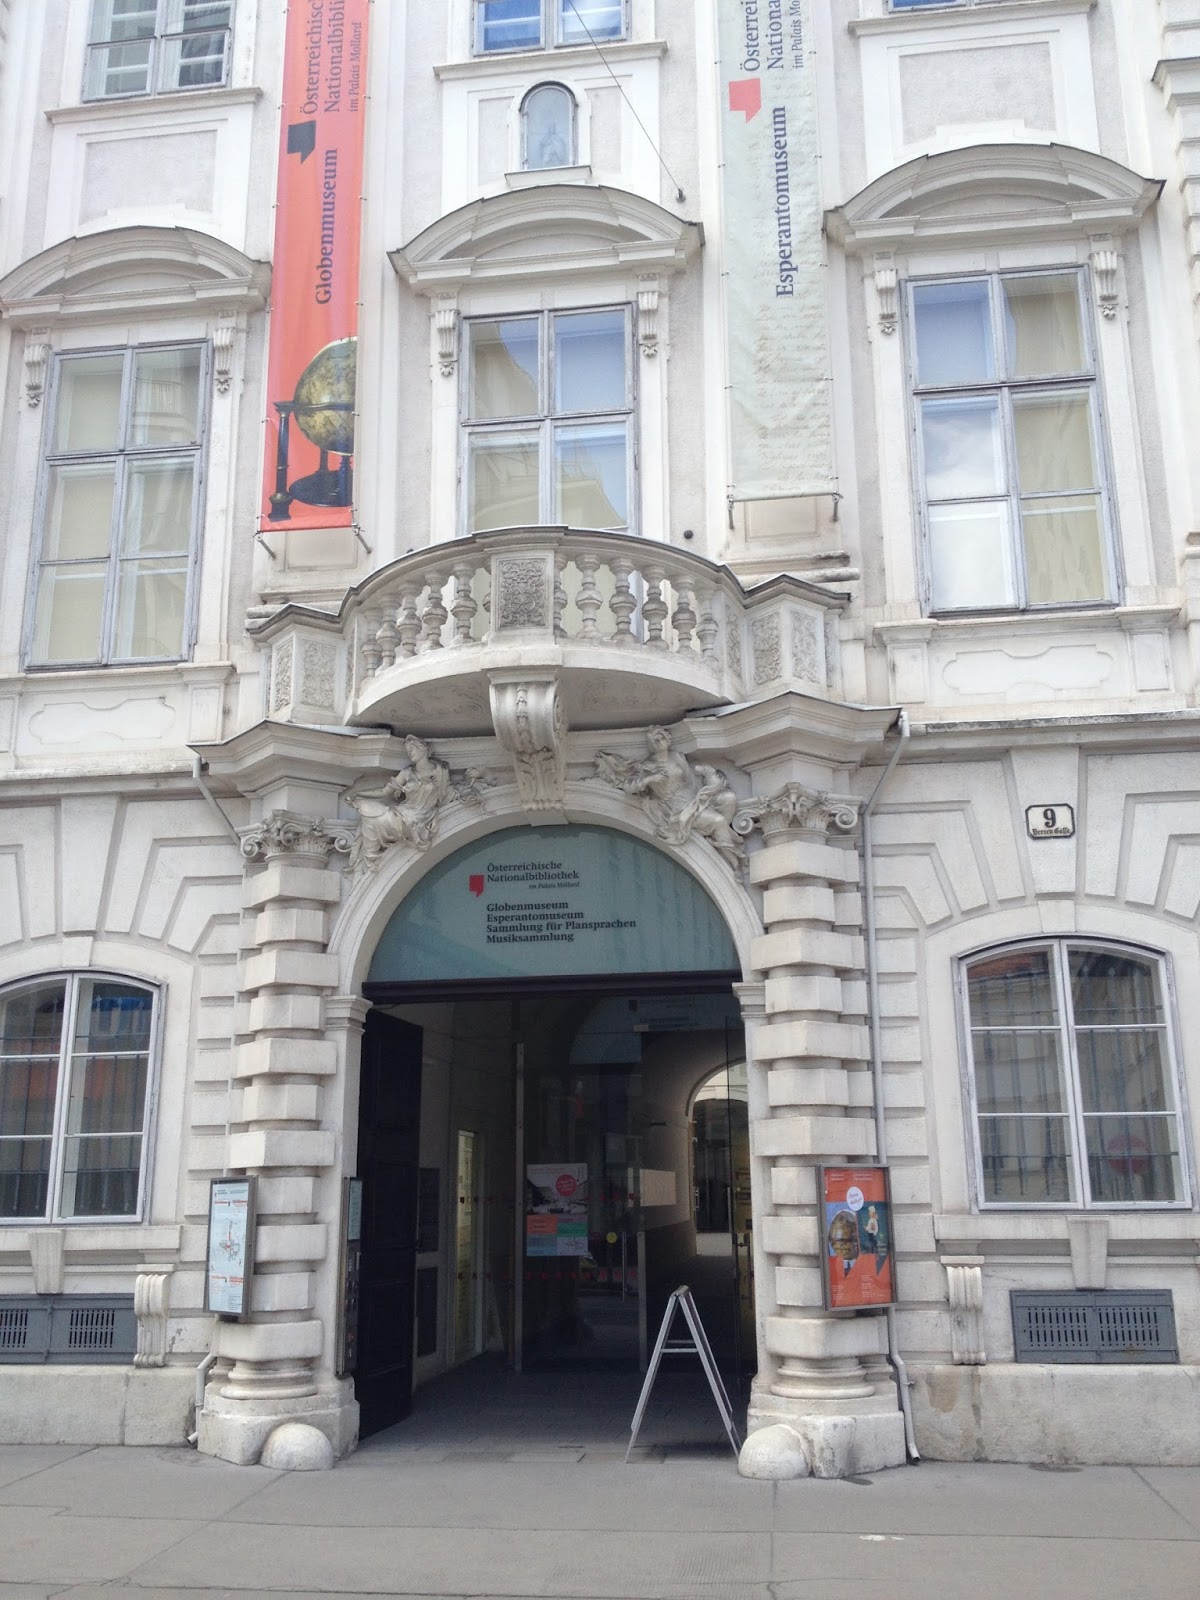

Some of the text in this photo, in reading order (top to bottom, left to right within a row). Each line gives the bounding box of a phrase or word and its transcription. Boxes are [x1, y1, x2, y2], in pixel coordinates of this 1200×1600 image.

[790, 19, 803, 51] Palais
[301, 0, 323, 114] Österreichisc
[793, 54, 804, 69] im
[348, 22, 362, 112] im Palais Mollard
[774, 106, 799, 298] Esperantomuseum
[315, 148, 338, 305] Globenmuseum
[1043, 808, 1056, 828] 9
[487, 861, 562, 872] Österreichische
[487, 871, 580, 882] Nationalbibliothek
[486, 901, 569, 912] Globenmuseum
[486, 911, 584, 924] Esperantomuseum
[486, 919, 637, 933] Sammlung für Plansprachen
[486, 933, 574, 943] Musiksammlung
